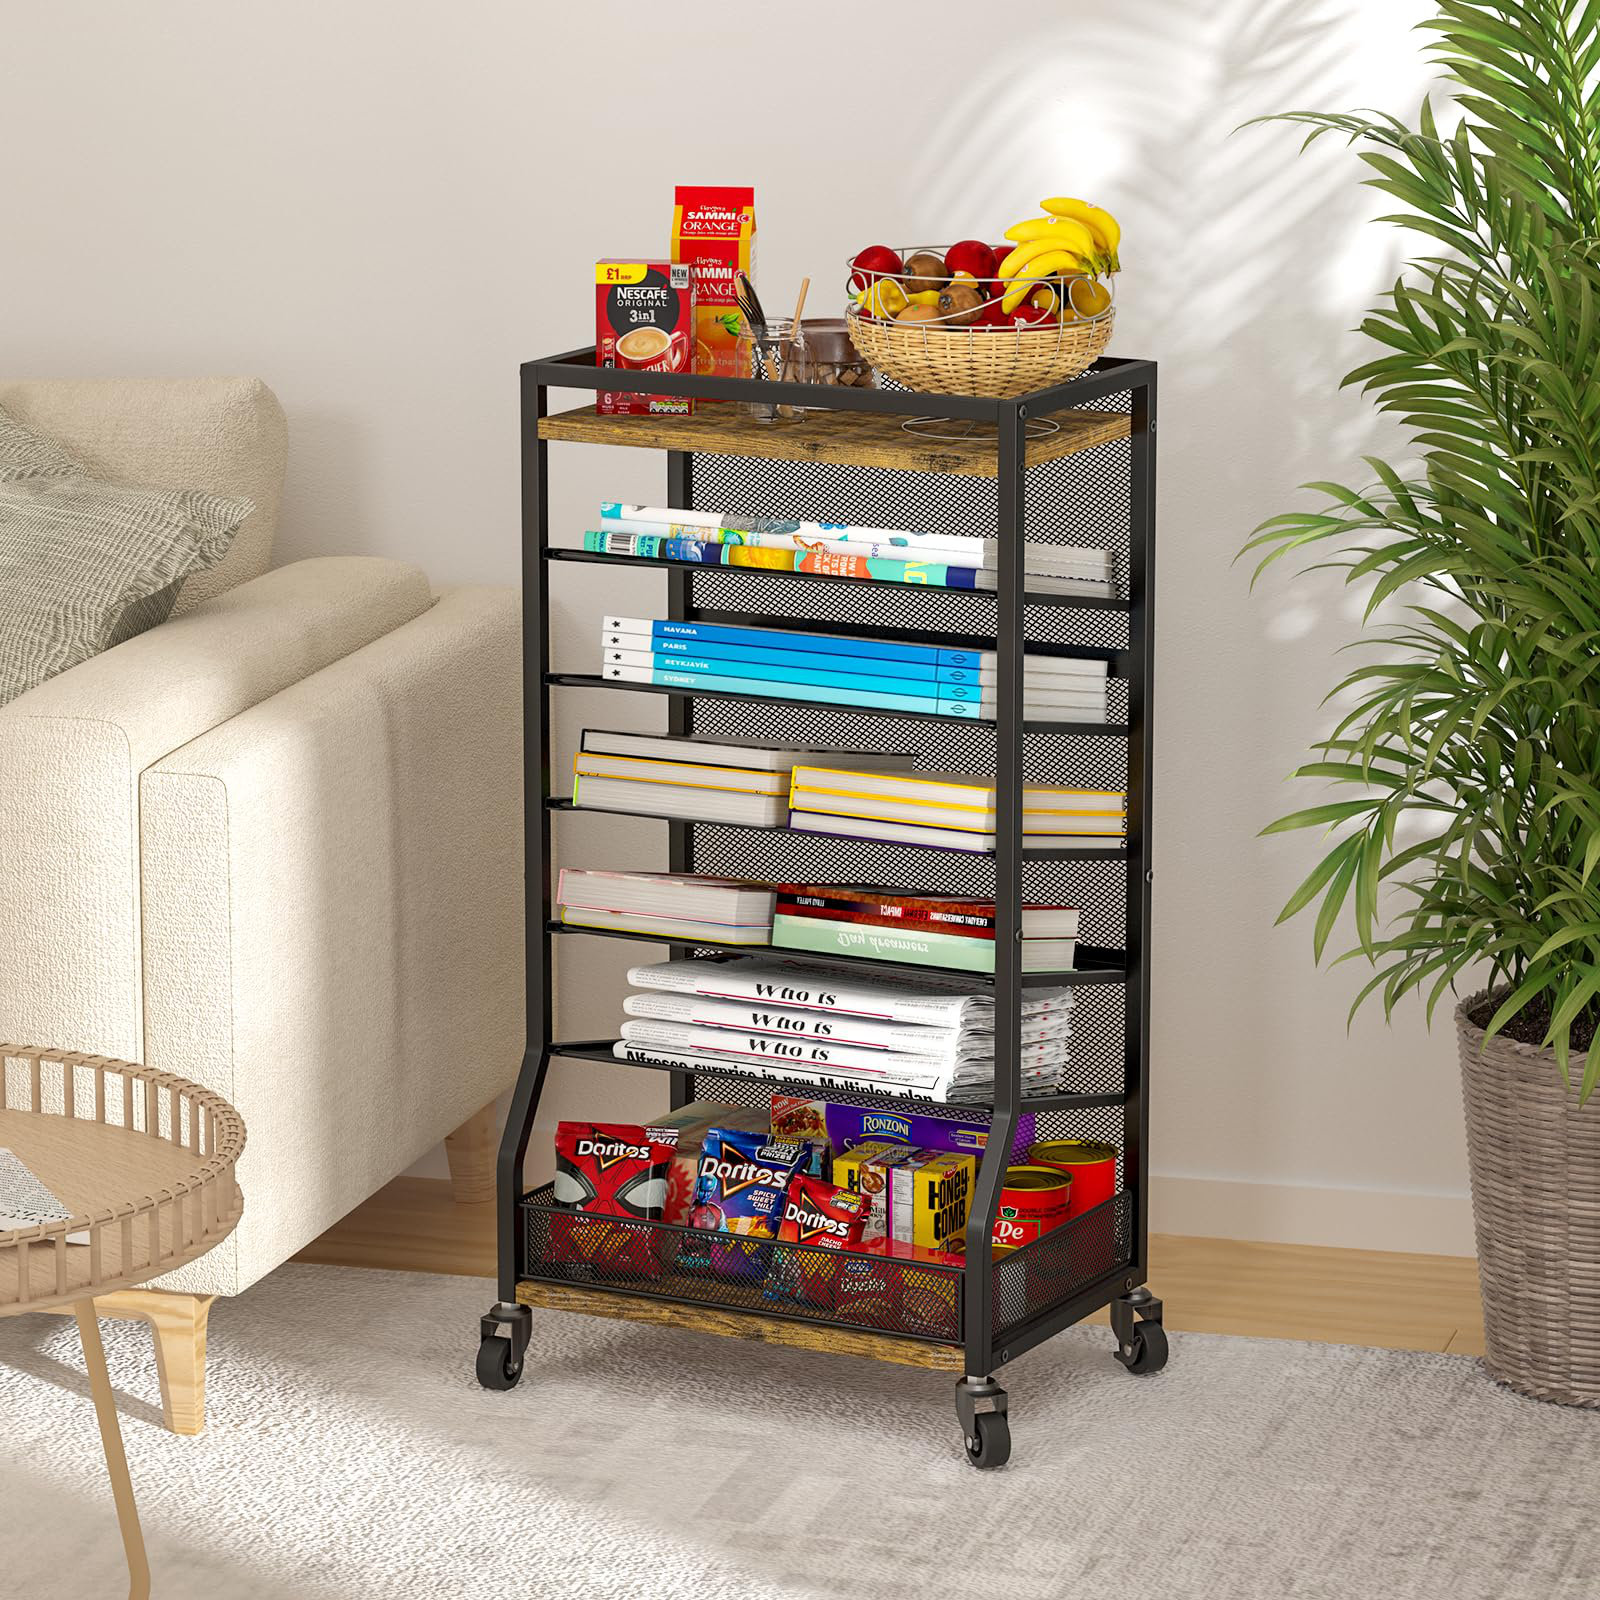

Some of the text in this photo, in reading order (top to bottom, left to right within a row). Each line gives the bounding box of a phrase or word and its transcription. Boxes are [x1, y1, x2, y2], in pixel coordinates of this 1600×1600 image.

[683, 221, 738, 231] ORANGE
[606, 268, 619, 280] £1
[672, 269, 687, 278] NEW
[690, 267, 733, 279] AMMI
[617, 284, 668, 300] NESCAFÉ
[616, 299, 668, 307] ORIGINAL
[629, 309, 656, 323] 3in1
[604, 392, 612, 405] 6
[663, 626, 698, 635] HAVANA
[662, 642, 687, 651] PARIS
[663, 674, 697, 684] SYDNEY
[756, 983, 837, 1006] Who is
[752, 1012, 833, 1035] Who is
[749, 1038, 830, 1061] Who is
[773, 1097, 789, 1111] NOW
[863, 1116, 909, 1137] RONZONI
[577, 1140, 651, 1160] Doritos
[760, 1151, 793, 1161] PRIZES
[700, 1157, 789, 1188] Doritos
[747, 1194, 776, 1205] SWEET
[753, 1189, 777, 1199] SPICY
[752, 1202, 774, 1210] CHILI
[784, 1203, 850, 1237] Doritos
[934, 1198, 966, 1241] COMB
[994, 1220, 1024, 1240] De
[821, 1236, 843, 1247] NACHO
